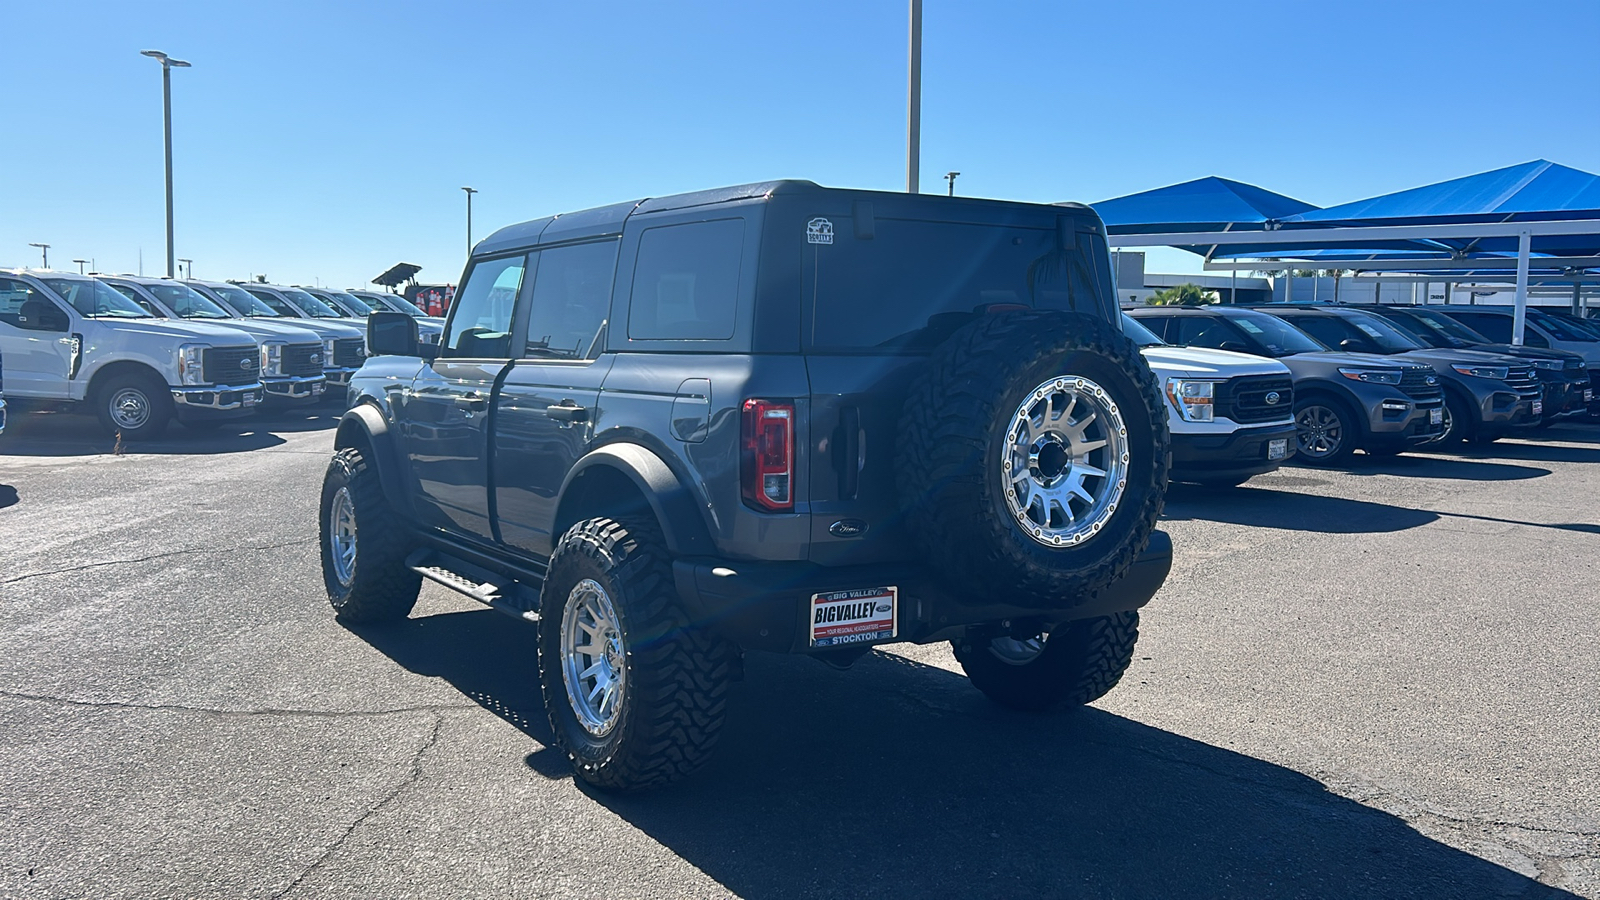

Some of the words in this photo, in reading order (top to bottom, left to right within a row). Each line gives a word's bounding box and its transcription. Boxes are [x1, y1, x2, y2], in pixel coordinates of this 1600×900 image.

[849, 589, 878, 598] VALLEY
[814, 601, 877, 624] BIGVALLEY
[832, 632, 878, 644] STOCKTON
